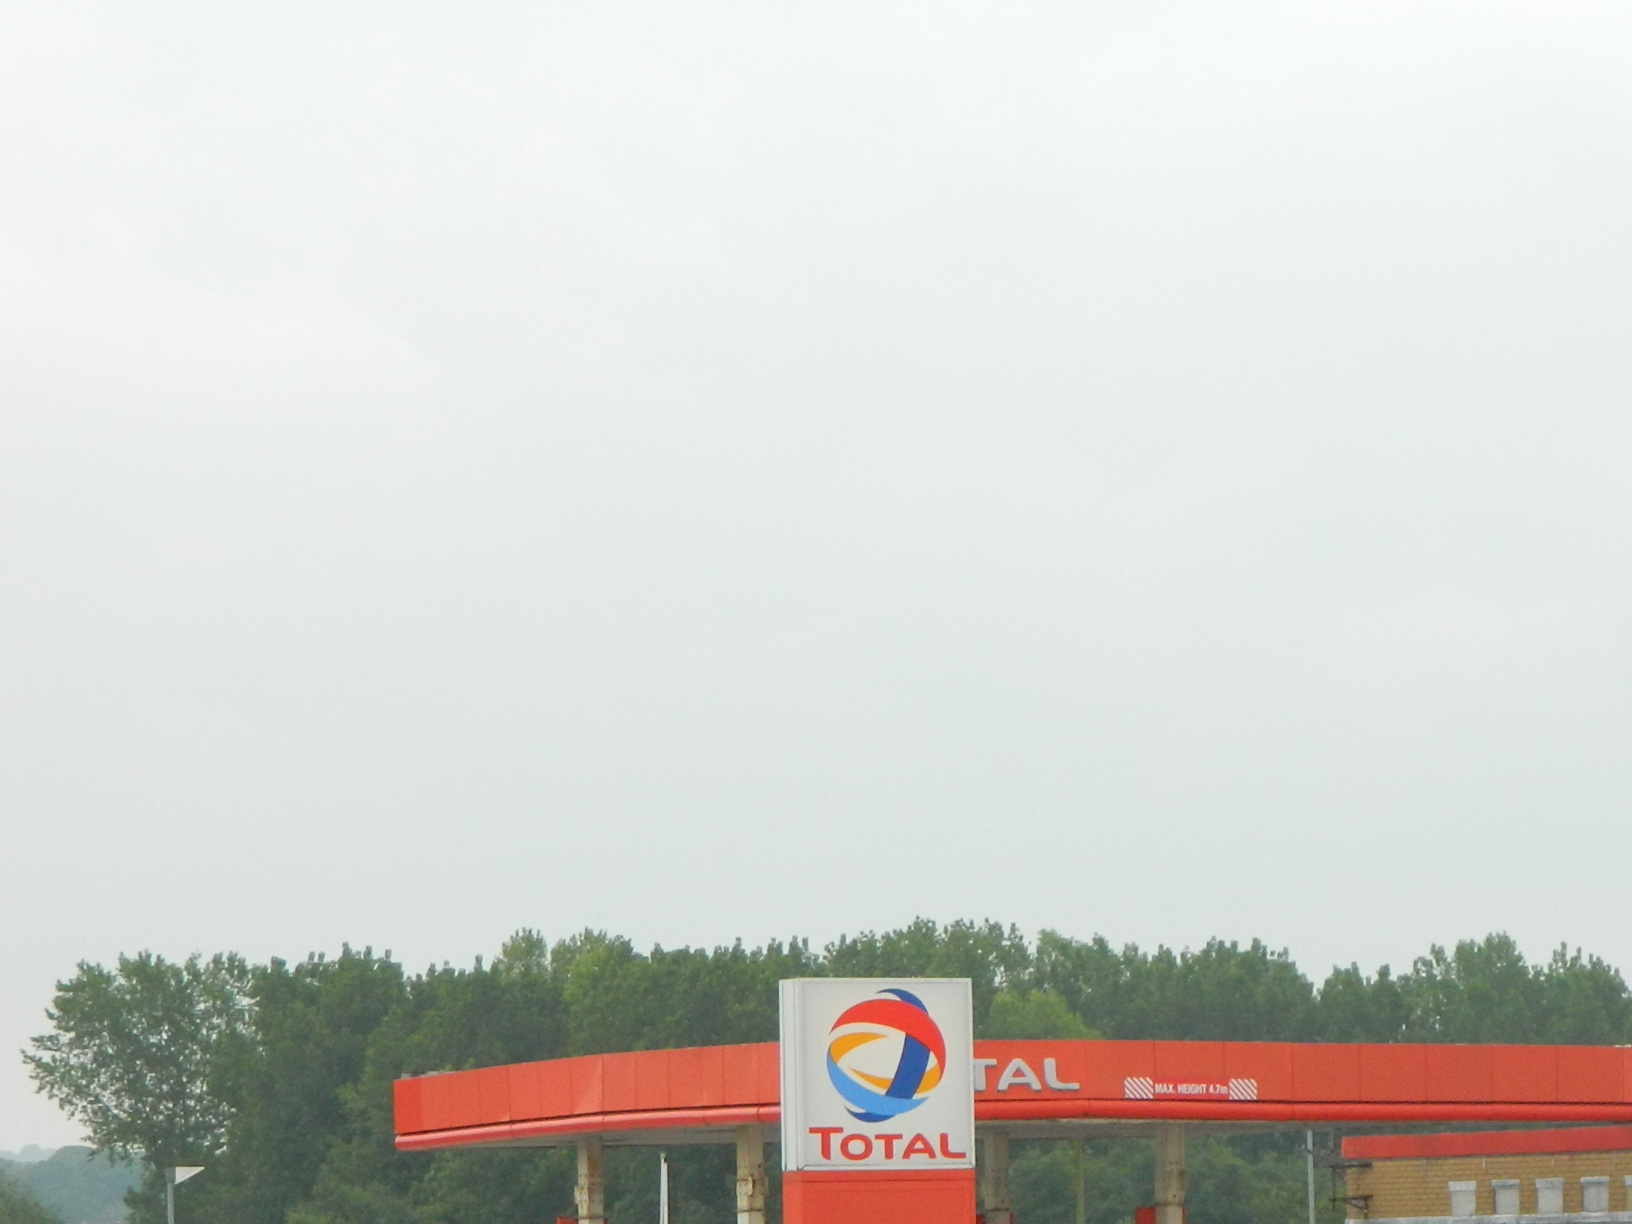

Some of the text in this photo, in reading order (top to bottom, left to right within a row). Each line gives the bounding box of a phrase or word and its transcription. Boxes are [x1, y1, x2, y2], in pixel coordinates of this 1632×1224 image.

[974, 1058, 1080, 1091] TAL
[1177, 1083, 1207, 1095] HEIGHT
[808, 1127, 967, 1161] TOTAL
